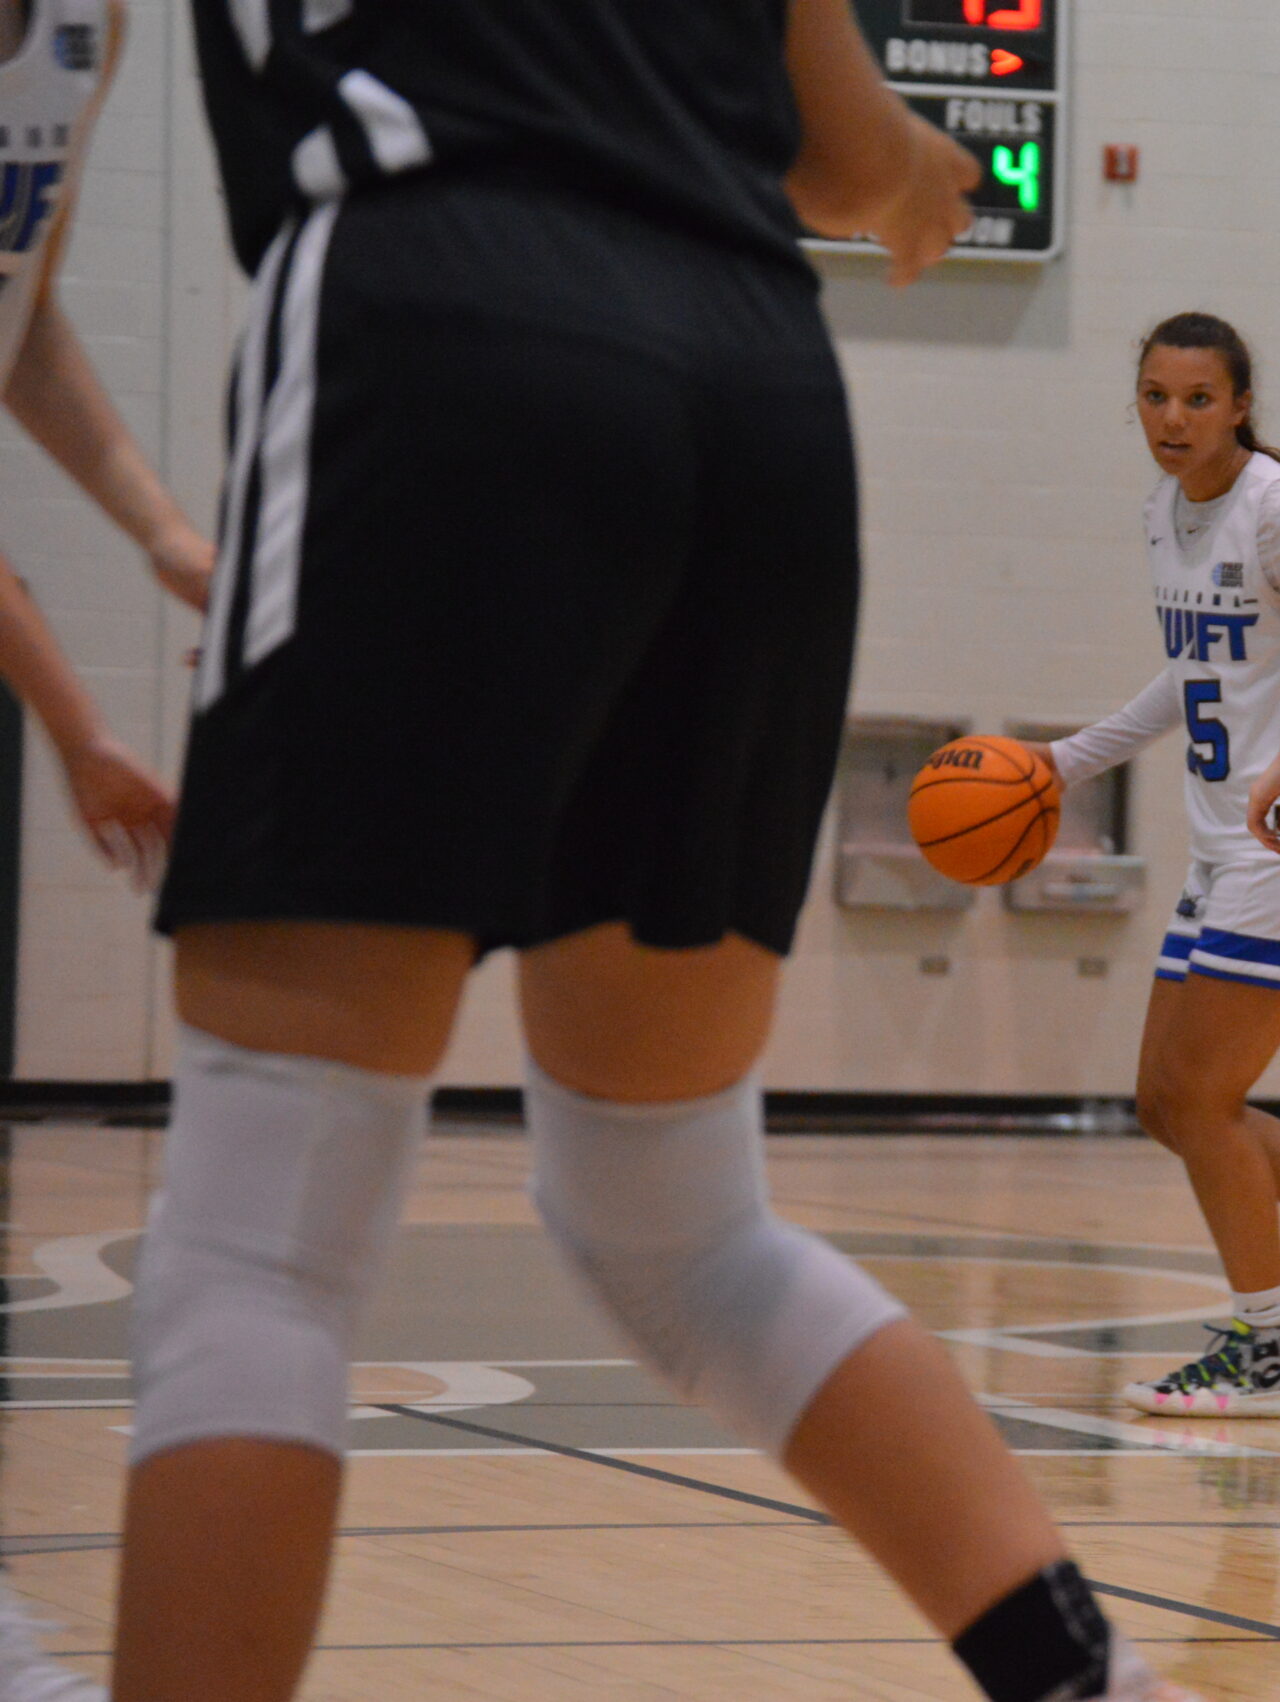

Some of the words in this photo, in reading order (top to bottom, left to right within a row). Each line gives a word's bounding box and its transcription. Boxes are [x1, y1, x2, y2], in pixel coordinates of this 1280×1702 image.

[886, 37, 989, 77] BONUS
[946, 100, 1042, 134] FOULS
[992, 141, 1039, 212] 4
[1184, 678, 1231, 783] 5
